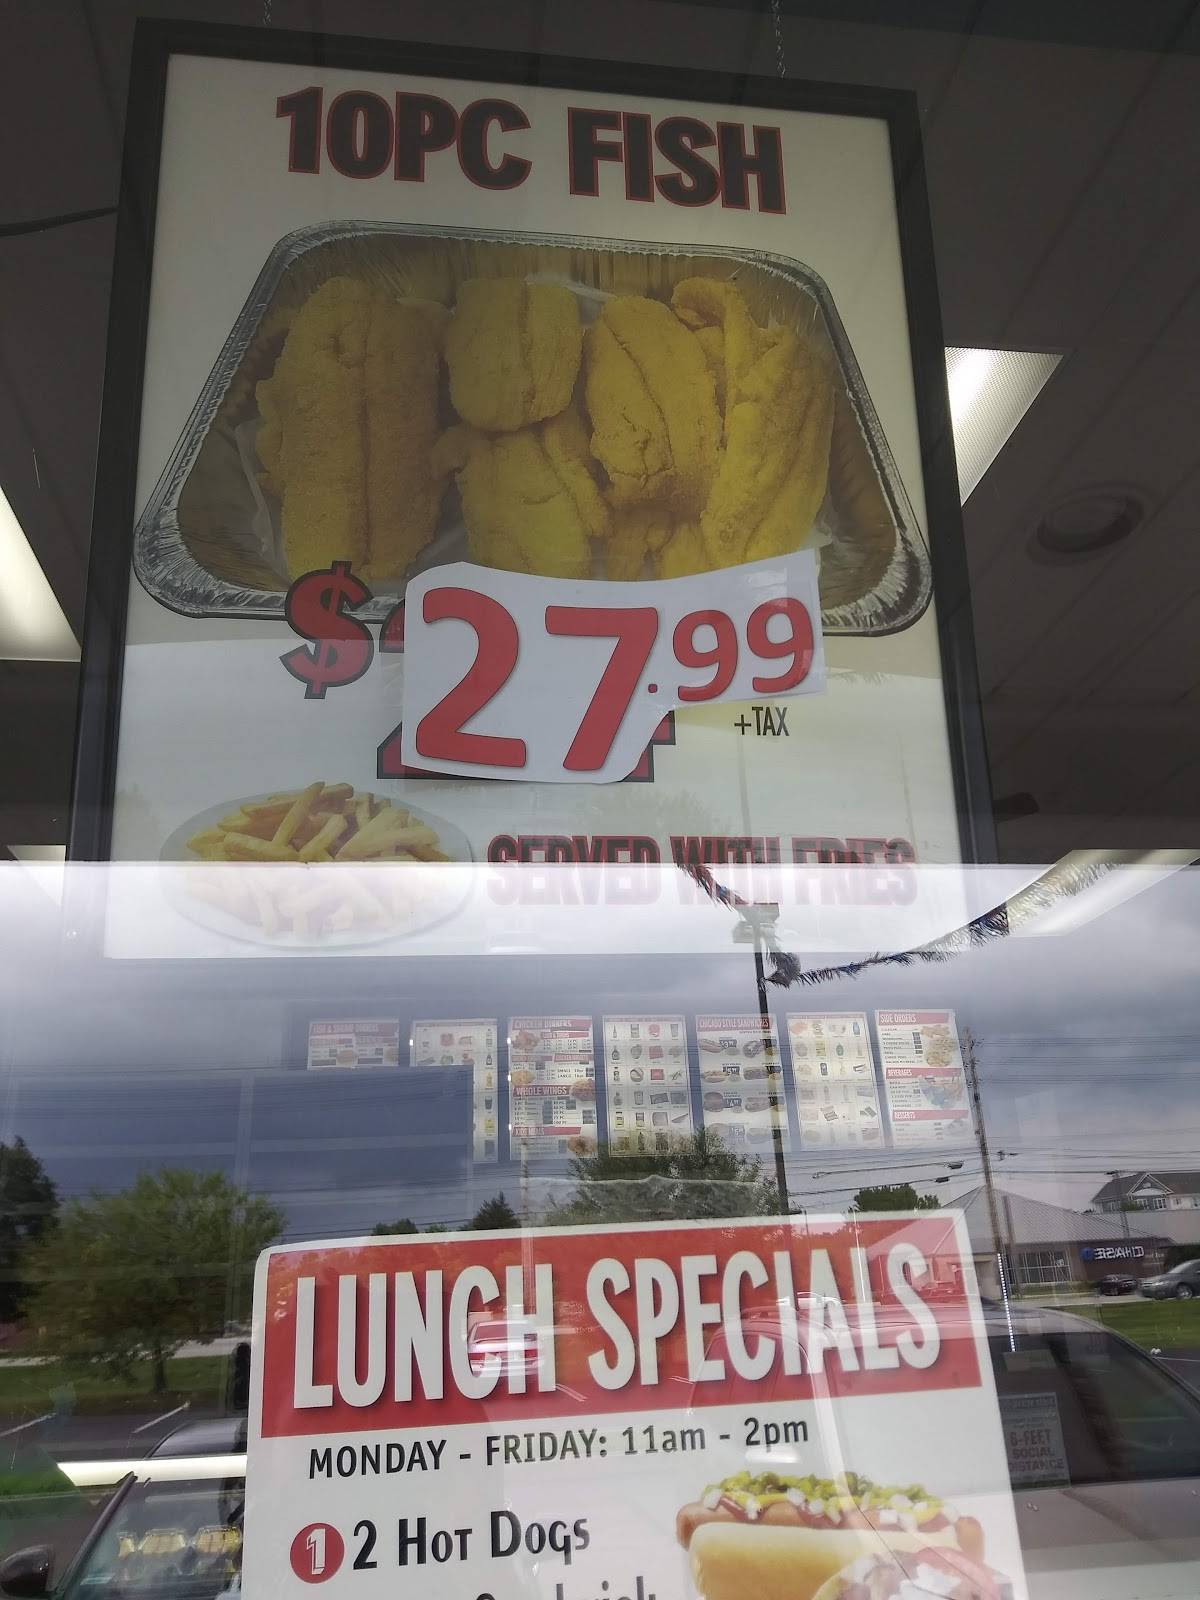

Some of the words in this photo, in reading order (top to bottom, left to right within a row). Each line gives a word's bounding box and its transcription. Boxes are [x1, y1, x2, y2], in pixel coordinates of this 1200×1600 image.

[276, 86, 533, 191] 10PC
[567, 106, 787, 215] FISH
[279, 560, 375, 699] $
[415, 586, 815, 772] 27.99
[734, 706, 790, 737] +TAX
[487, 834, 661, 906] SERVED
[670, 835, 780, 906] WITH
[791, 836, 918, 906] FRIES
[516, 1086, 542, 1096] WHOLE
[543, 1086, 567, 1095] WINGS
[292, 1261, 556, 1410] LUNCH
[586, 1242, 941, 1391] SPECIALS
[308, 1439, 447, 1480] MONDAY
[485, 1427, 609, 1468] FRIDAY:
[623, 1423, 707, 1455] 11am
[744, 1416, 809, 1449] 2pm
[352, 1518, 378, 1571] 2
